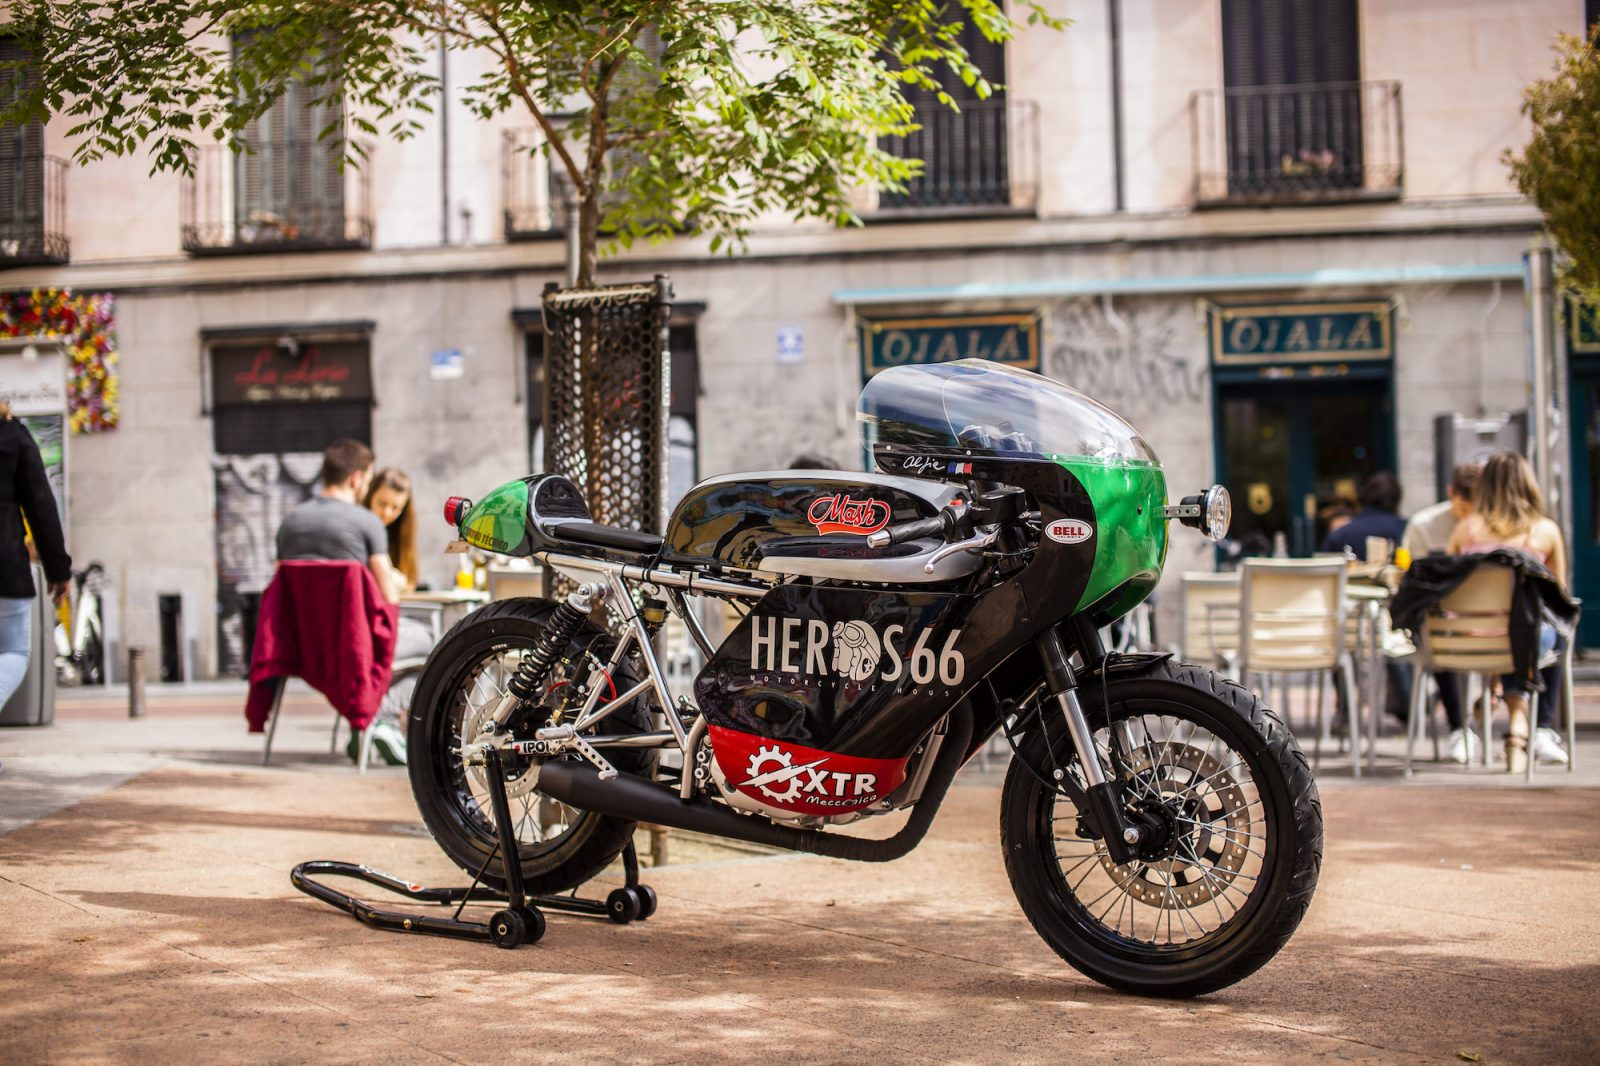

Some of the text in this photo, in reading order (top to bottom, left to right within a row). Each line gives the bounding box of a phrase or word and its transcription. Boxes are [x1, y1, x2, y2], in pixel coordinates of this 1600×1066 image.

[808, 493, 877, 526] Mash
[1053, 526, 1085, 536] BELL
[750, 674, 876, 692] MOTORCYCLE
[803, 766, 877, 797] XTR
